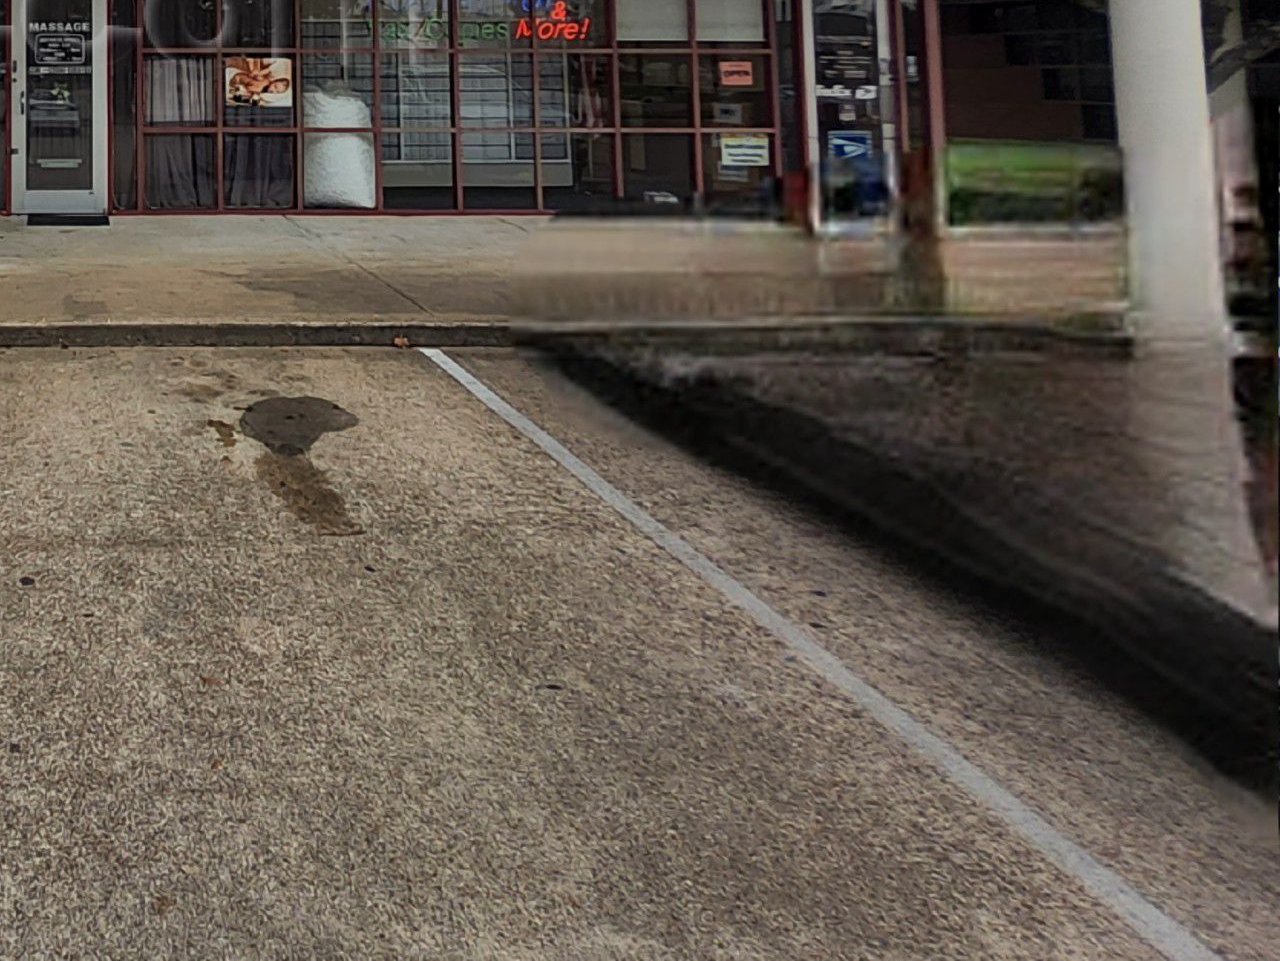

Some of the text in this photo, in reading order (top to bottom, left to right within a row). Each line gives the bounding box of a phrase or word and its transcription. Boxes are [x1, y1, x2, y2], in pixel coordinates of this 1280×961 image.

[551, 0, 567, 20] &
[28, 22, 90, 32] MASSAGE
[516, 17, 590, 40] More!
